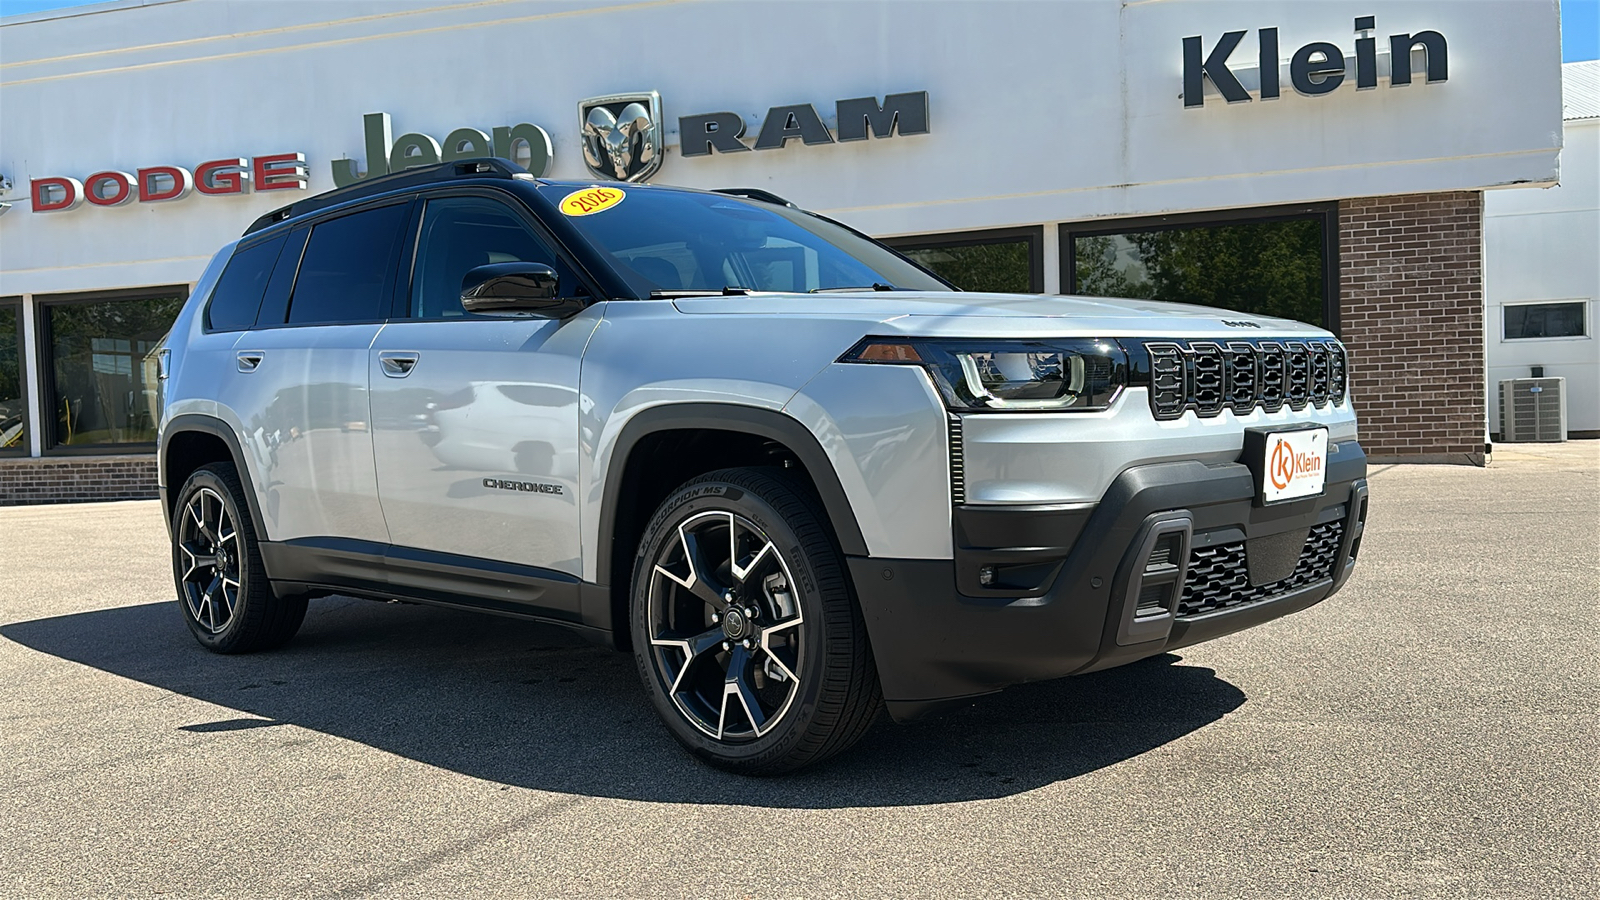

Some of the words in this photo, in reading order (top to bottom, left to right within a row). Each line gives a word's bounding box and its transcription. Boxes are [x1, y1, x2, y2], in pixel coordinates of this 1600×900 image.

[1182, 15, 1448, 109] Klein
[678, 90, 931, 157] RAM
[30, 152, 307, 213] DODGE
[570, 188, 615, 212] 2026
[1296, 451, 1321, 474] Klein
[482, 478, 563, 495] CHEROKEE
[650, 488, 702, 535] SCORPION
